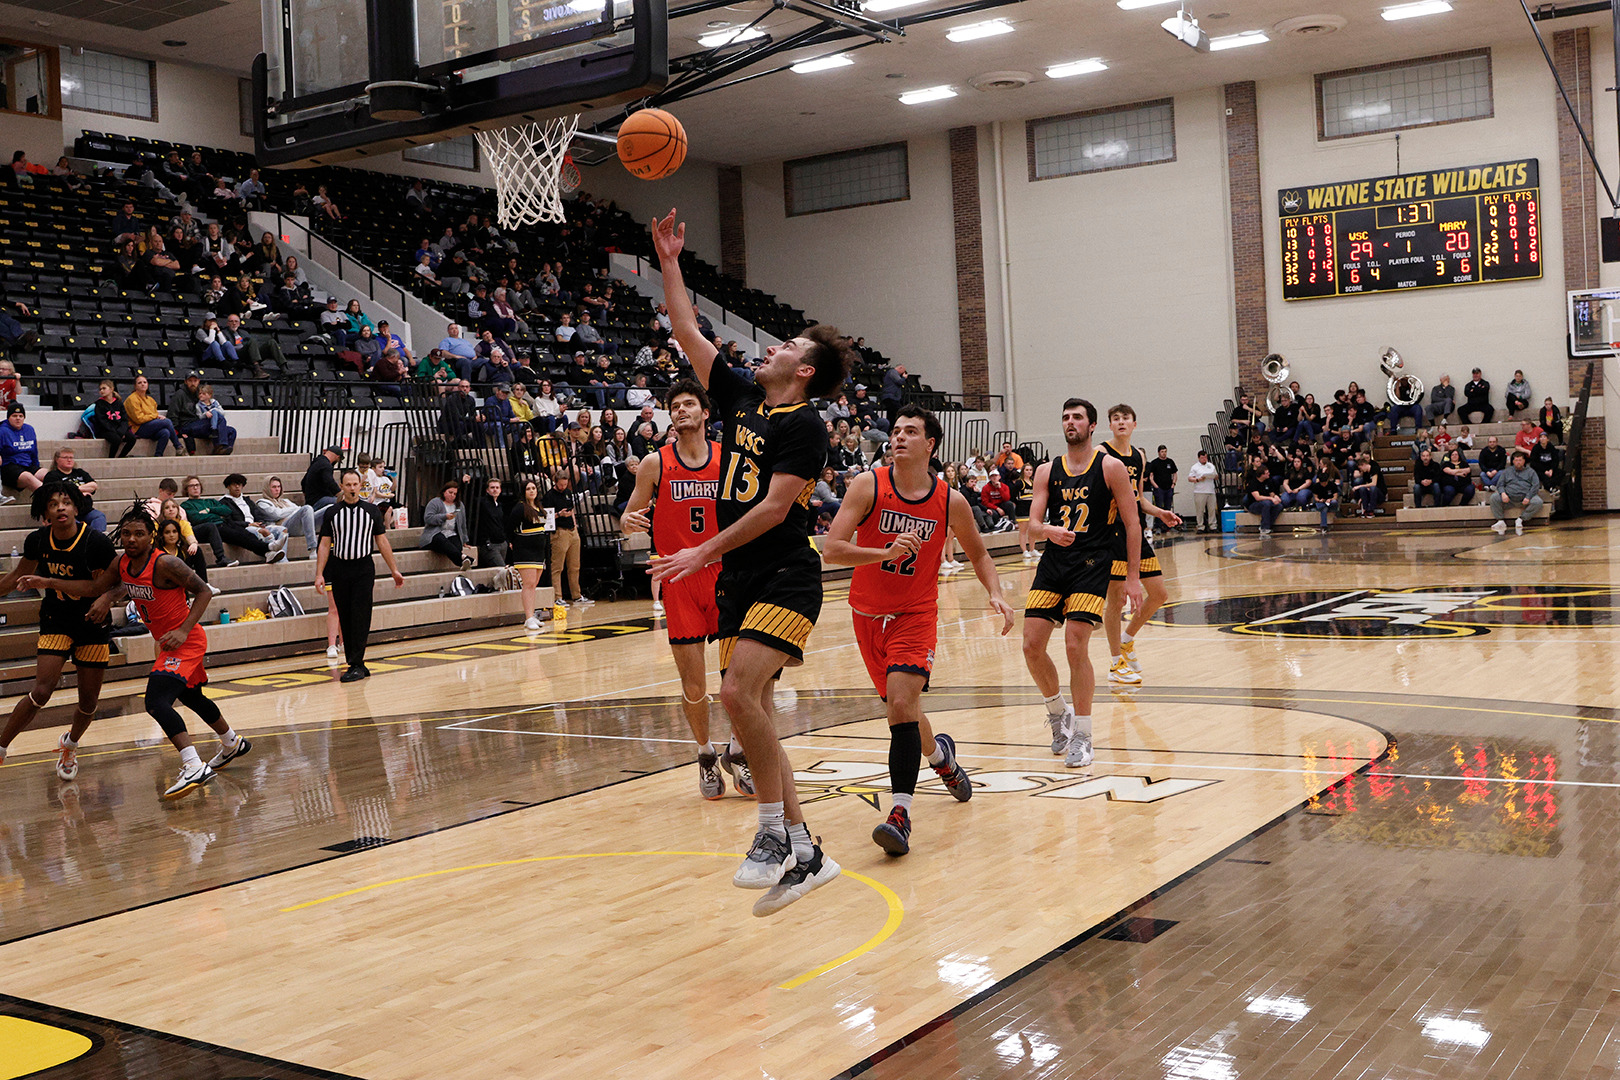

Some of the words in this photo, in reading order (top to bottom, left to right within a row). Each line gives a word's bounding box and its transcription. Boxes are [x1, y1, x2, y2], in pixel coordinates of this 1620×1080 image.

[1306, 181, 1370, 210] WAYNE
[1373, 174, 1427, 202] STATE
[1432, 163, 1528, 195] WILDCATS
[1484, 195, 1500, 205] PLY
[1502, 194, 1513, 203] FL
[1515, 191, 1532, 202] PTS
[1397, 202, 1431, 224] 1:37
[1489, 205, 1498, 217] 0
[1508, 203, 1517, 215] 0
[1527, 200, 1536, 213] 0
[1285, 218, 1299, 227] PLY
[1302, 216, 1310, 225] FL
[1313, 214, 1328, 224] PTS
[1439, 220, 1467, 232] MARY
[1490, 218, 1498, 228] 4
[1508, 215, 1517, 227] 0
[1528, 213, 1536, 225] 2
[1286, 227, 1298, 239] 10
[1306, 225, 1315, 237] 0
[1324, 223, 1332, 236] 0
[1395, 230, 1416, 239] PERIOD
[1509, 228, 1518, 239] 0
[1528, 225, 1537, 237] 0
[1287, 239, 1298, 250] 13
[1311, 238, 1316, 248] 1
[1324, 235, 1333, 247] 6
[1406, 240, 1412, 253] 1
[1445, 231, 1470, 252] 20
[1483, 242, 1499, 255] 22
[1513, 240, 1519, 250] 1
[1529, 238, 1537, 250] 2
[1284, 250, 1298, 263] 23
[1307, 249, 1316, 260] 0
[1325, 247, 1333, 259] 3
[1350, 241, 1374, 261] 29
[1452, 251, 1471, 259] FOULS
[1484, 255, 1500, 267] 24
[1514, 252, 1519, 263] 1
[1529, 250, 1538, 262] 8
[1286, 262, 1299, 274] 32
[1312, 261, 1316, 271] 1
[1322, 259, 1333, 270] 12
[1343, 262, 1361, 270] FOULS
[1388, 258, 1410, 266] PLAYER
[1410, 256, 1425, 264] FOUL
[1436, 260, 1445, 276] 3
[1460, 258, 1471, 274] 6
[1286, 274, 1300, 286] 35
[1309, 272, 1317, 284] 2
[1327, 270, 1334, 282] 3
[1350, 268, 1360, 284] 6
[1370, 268, 1381, 281] 4
[1397, 280, 1417, 288] MATCH
[735, 424, 765, 456] WSC
[721, 451, 760, 502] 13
[670, 480, 719, 501] UMARY
[1061, 486, 1090, 501] WSC
[690, 507, 705, 533] 5
[879, 510, 937, 541] UMARY
[1059, 503, 1090, 533] 32
[47, 562, 74, 577] WSC
